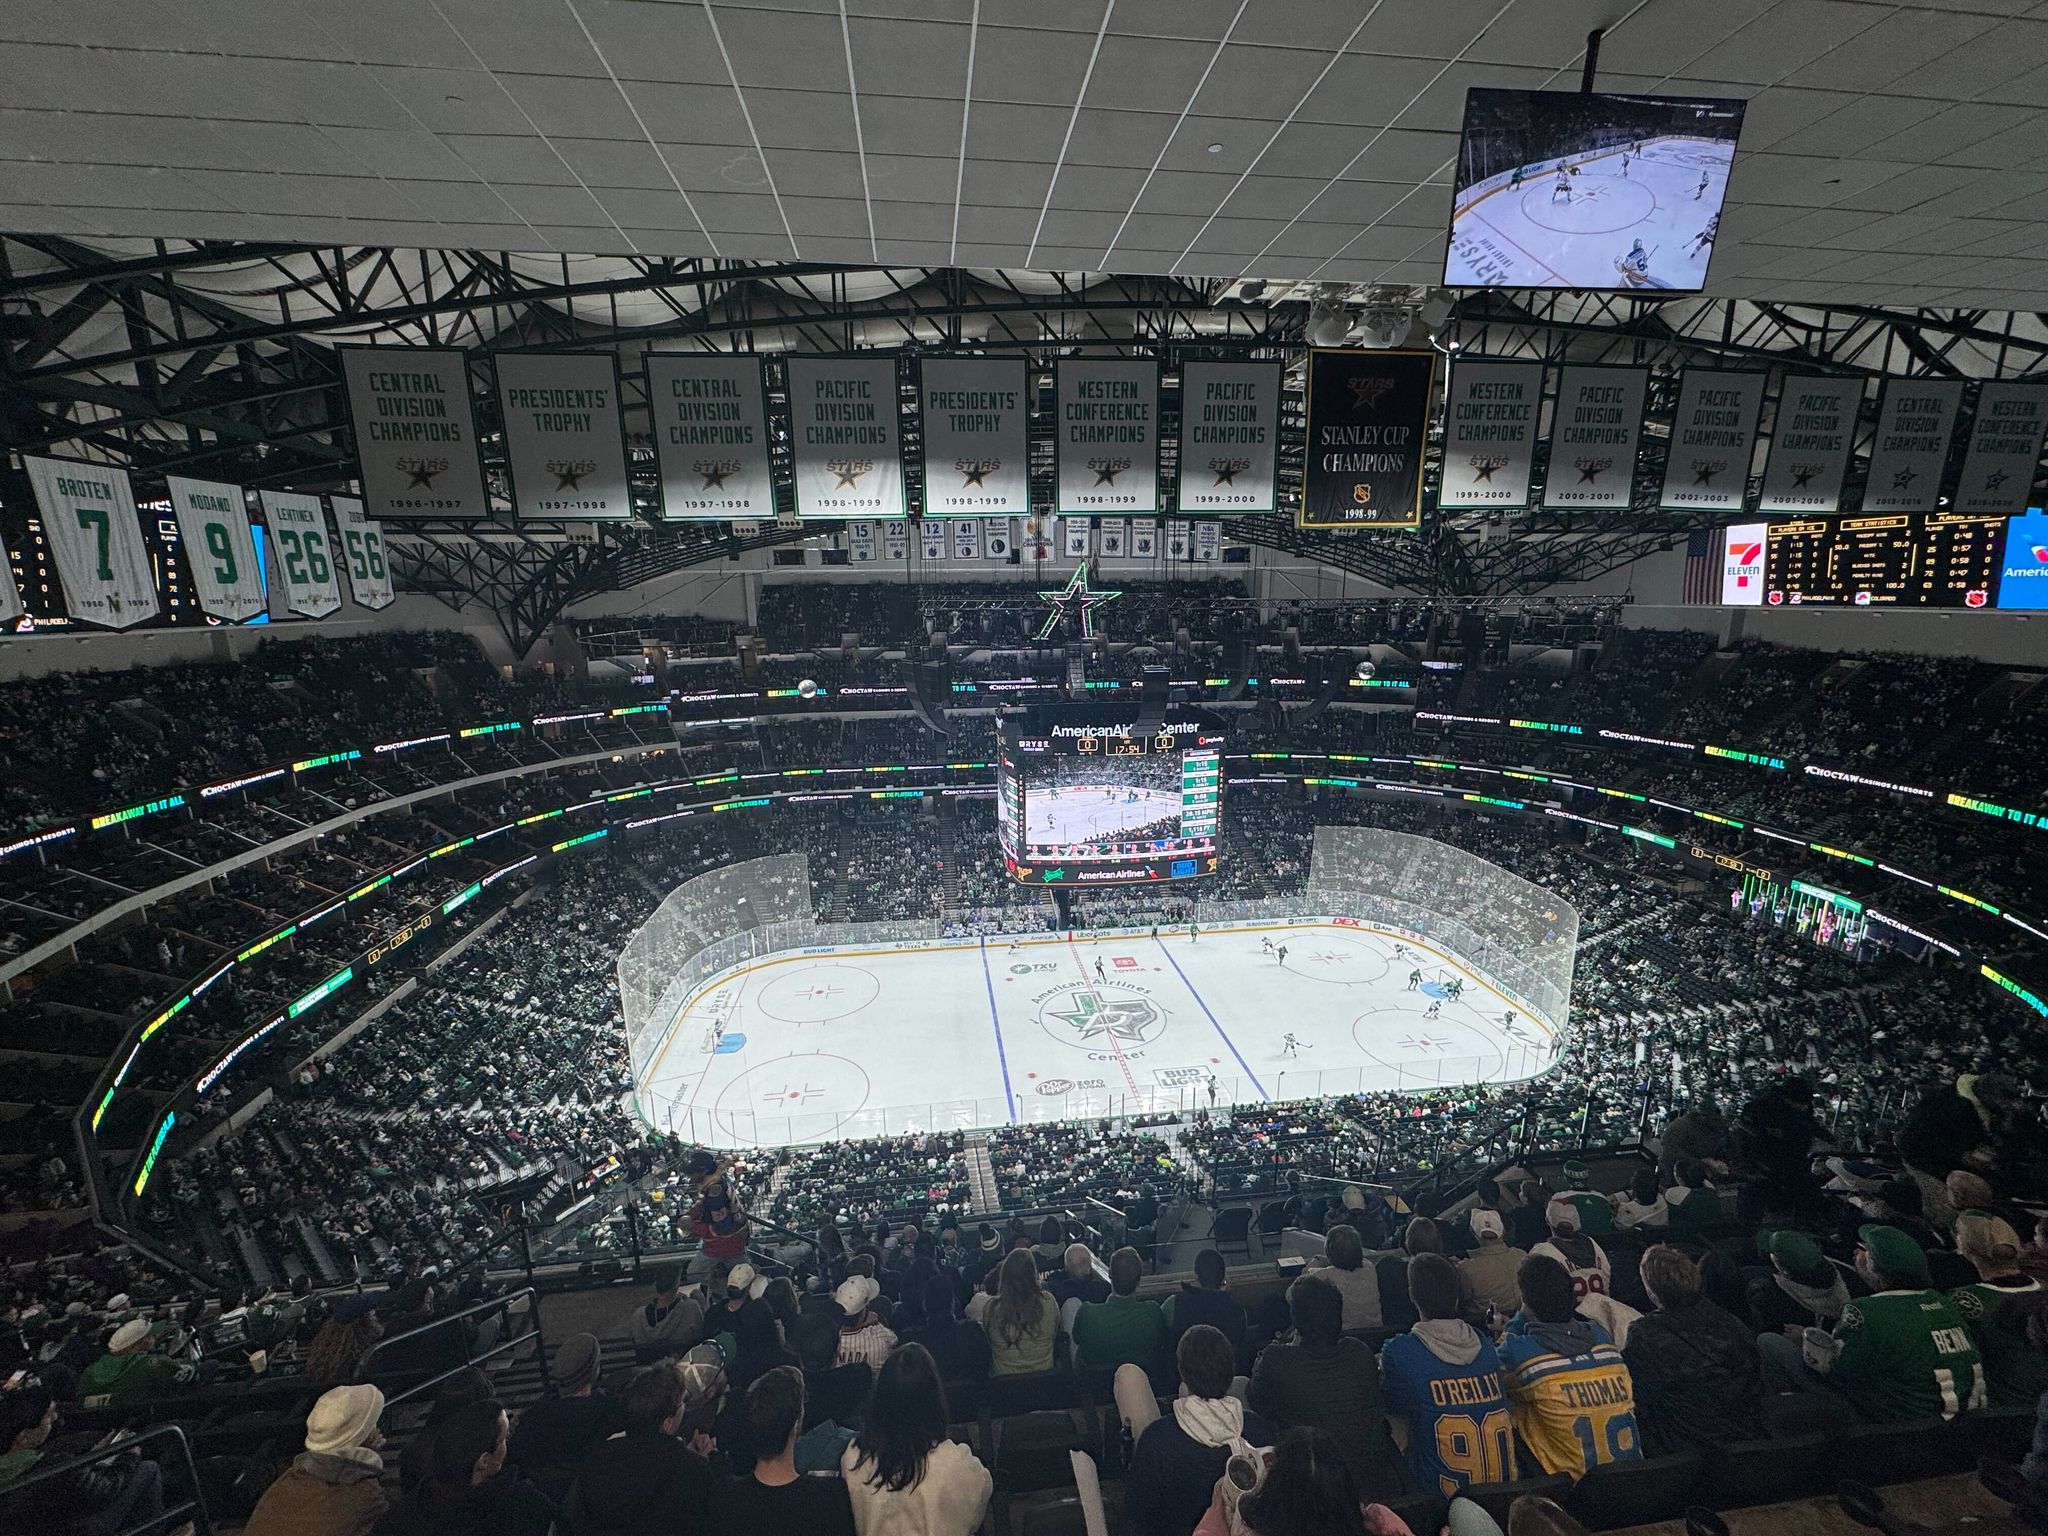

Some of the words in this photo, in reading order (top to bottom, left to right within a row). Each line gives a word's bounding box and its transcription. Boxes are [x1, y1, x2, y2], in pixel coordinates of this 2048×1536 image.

[369, 372, 445, 394] CENTRAL
[672, 379, 742, 398] CENTRAL
[816, 380, 871, 398] PACIFIC
[1078, 381, 1138, 398] WESTERN
[1206, 383, 1255, 400] PACIFIC
[1469, 383, 1523, 399] WESTERN
[509, 389, 608, 408] PRESIDENTS'
[930, 392, 1018, 410] PRESIDENTS'
[1580, 386, 1624, 403] PACIFIC
[1699, 390, 1741, 407] PACIFIC
[1799, 395, 1841, 411] PACIFIC
[378, 397, 447, 417] DIVISION
[679, 403, 740, 421] DIVISION
[815, 403, 874, 421] DIVISION
[1066, 403, 1148, 421] CONFERENCE
[1203, 404, 1256, 422] DIVISION
[1456, 404, 1531, 420] CONFERENCE
[1896, 399, 1943, 413] CENTRAL
[533, 413, 591, 432] TROPHY
[949, 414, 1000, 432] TROPHY
[1575, 407, 1623, 423] DIVISION
[1693, 409, 1741, 426] DIVISION
[1792, 414, 1840, 430] DIVISION
[369, 422, 461, 442] CHAMPIONS
[1458, 425, 1525, 441] CHAMPIONS
[1895, 417, 1939, 432] DIVISION
[670, 426, 752, 444] CHAMPIONS
[806, 426, 886, 444] CHAMPIONS
[1071, 426, 1144, 443] CHAMPIONS
[1193, 426, 1265, 444] CHAMPIONS
[1321, 425, 1379, 445] STANLEY
[1383, 426, 1409, 445] CUP
[1564, 428, 1628, 444] CHAMPIONS
[1683, 429, 1745, 447] CHAMPIONS
[1782, 433, 1842, 450] CHAMPIONS
[1883, 437, 1941, 452] CHAMPIONS
[1323, 453, 1404, 472] CHAMPIONS
[57, 477, 113, 500] BROTEN
[189, 494, 231, 512] MODANO
[389, 500, 461, 508] 1996-1997
[538, 501, 606, 509] 1997-1998
[685, 500, 750, 508] 1997-1998
[818, 499, 881, 507] 1998-1999
[945, 497, 1007, 505] 1998-1999
[1195, 495, 1255, 503] 1999-2000
[276, 508, 315, 522] LEHTINEN
[1345, 508, 1377, 519] 1998-99
[855, 525, 868, 537] 15
[889, 522, 904, 535] 22
[925, 523, 939, 534] 12
[960, 523, 971, 534] 41
[75, 509, 114, 581] 7
[205, 522, 238, 584] 9
[278, 530, 330, 584] 26
[345, 530, 385, 579] 56
[1729, 543, 1761, 565] 7
[683, 694, 716, 702] CHOCTAW
[816, 688, 827, 696] ALL
[536, 715, 567, 725] CHOCTAW
[1418, 711, 1453, 720] CHOCTAW
[460, 726, 494, 737] BREAKAWAY
[1157, 722, 1199, 734] Center
[1509, 719, 1548, 732] BREAKAWAY
[1550, 723, 1559, 732] TO
[1560, 724, 1567, 733] IT
[1569, 726, 1582, 734] ALL
[1602, 730, 1641, 742] CHOCTAW
[1670, 742, 1694, 750] RESORTS
[1115, 745, 1140, 754] 17:54
[1704, 745, 1746, 762] BREAKAWAY
[1748, 754, 1758, 764] TO
[1760, 756, 1768, 766] IT
[1769, 758, 1784, 769] ALL
[292, 756, 329, 772] BREAKAWAY
[331, 754, 340, 762] TO
[349, 750, 361, 759] ALL
[205, 780, 242, 796] CHOCTAW
[1809, 766, 1859, 783] CHOCTAW
[1859, 777, 1891, 789] CASINOS
[1899, 786, 1934, 797] RESORTS
[91, 806, 145, 830] BREAKAWAY
[146, 801, 158, 813] TO
[159, 800, 167, 811] IT
[169, 795, 185, 807] ALL
[1549, 809, 1577, 820] CHOCTAW
[1947, 793, 2005, 817] BREAKAWAY
[2008, 809, 2021, 821] TO
[2023, 813, 2036, 825] IT
[5, 838, 35, 853] CASINOS
[42, 827, 75, 841] RESORTS
[1078, 871, 1116, 880] American
[1116, 869, 1145, 879] Airlines
[1173, 868, 1196, 876] LIGHT
[1246, 920, 1279, 928] ticketmaster
[1332, 917, 1361, 927] DEX
[1870, 910, 1908, 933] CHOCTAW
[817, 946, 835, 954] LIGHT
[1032, 980, 1085, 1004] American
[1093, 979, 1152, 994] Airlines
[2001, 975, 2013, 992] THE
[199, 1054, 233, 1091] CHOCTAW
[259, 1015, 285, 1037] RESORTS
[1087, 1049, 1146, 1061] Center
[1164, 1069, 1200, 1078] BUD
[1930, 1327, 1971, 1354] BENN
[1430, 1372, 1502, 1407] O'REILLY
[1560, 1375, 1630, 1409] THOMAS
[1434, 1408, 1519, 1500] 90
